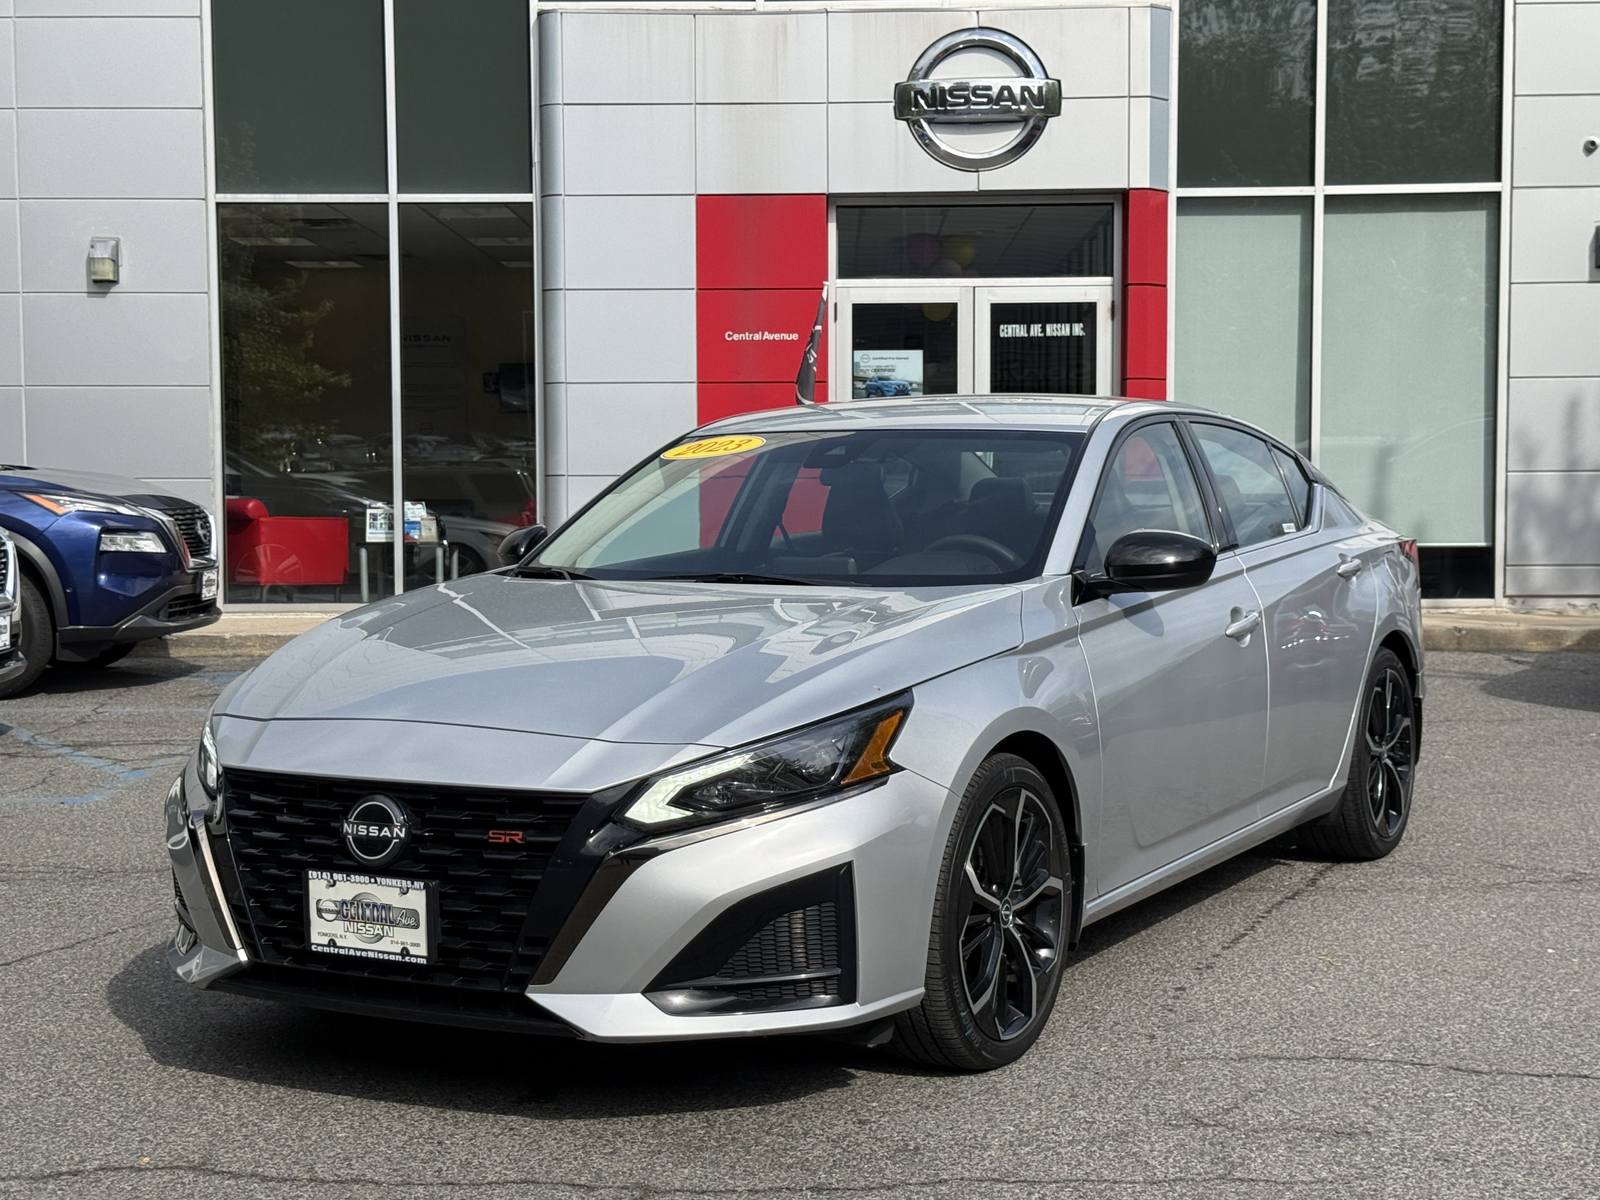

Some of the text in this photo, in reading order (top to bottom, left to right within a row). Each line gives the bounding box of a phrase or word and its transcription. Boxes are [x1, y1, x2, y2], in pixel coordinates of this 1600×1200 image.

[911, 84, 1046, 111] NISSAN
[724, 331, 799, 341] Central Avenue
[999, 322, 1086, 338] CENTRAL AVE. NISSAN INC.
[672, 438, 753, 457] 2023
[343, 822, 406, 838] NISSAN
[488, 829, 524, 844] SR
[308, 870, 331, 880] (914)
[333, 873, 370, 884] 961-3900
[341, 900, 418, 927] CENTRAL Ave.
[343, 921, 395, 938] NISSAN
[311, 944, 427, 965] CentralAveNissan.com
